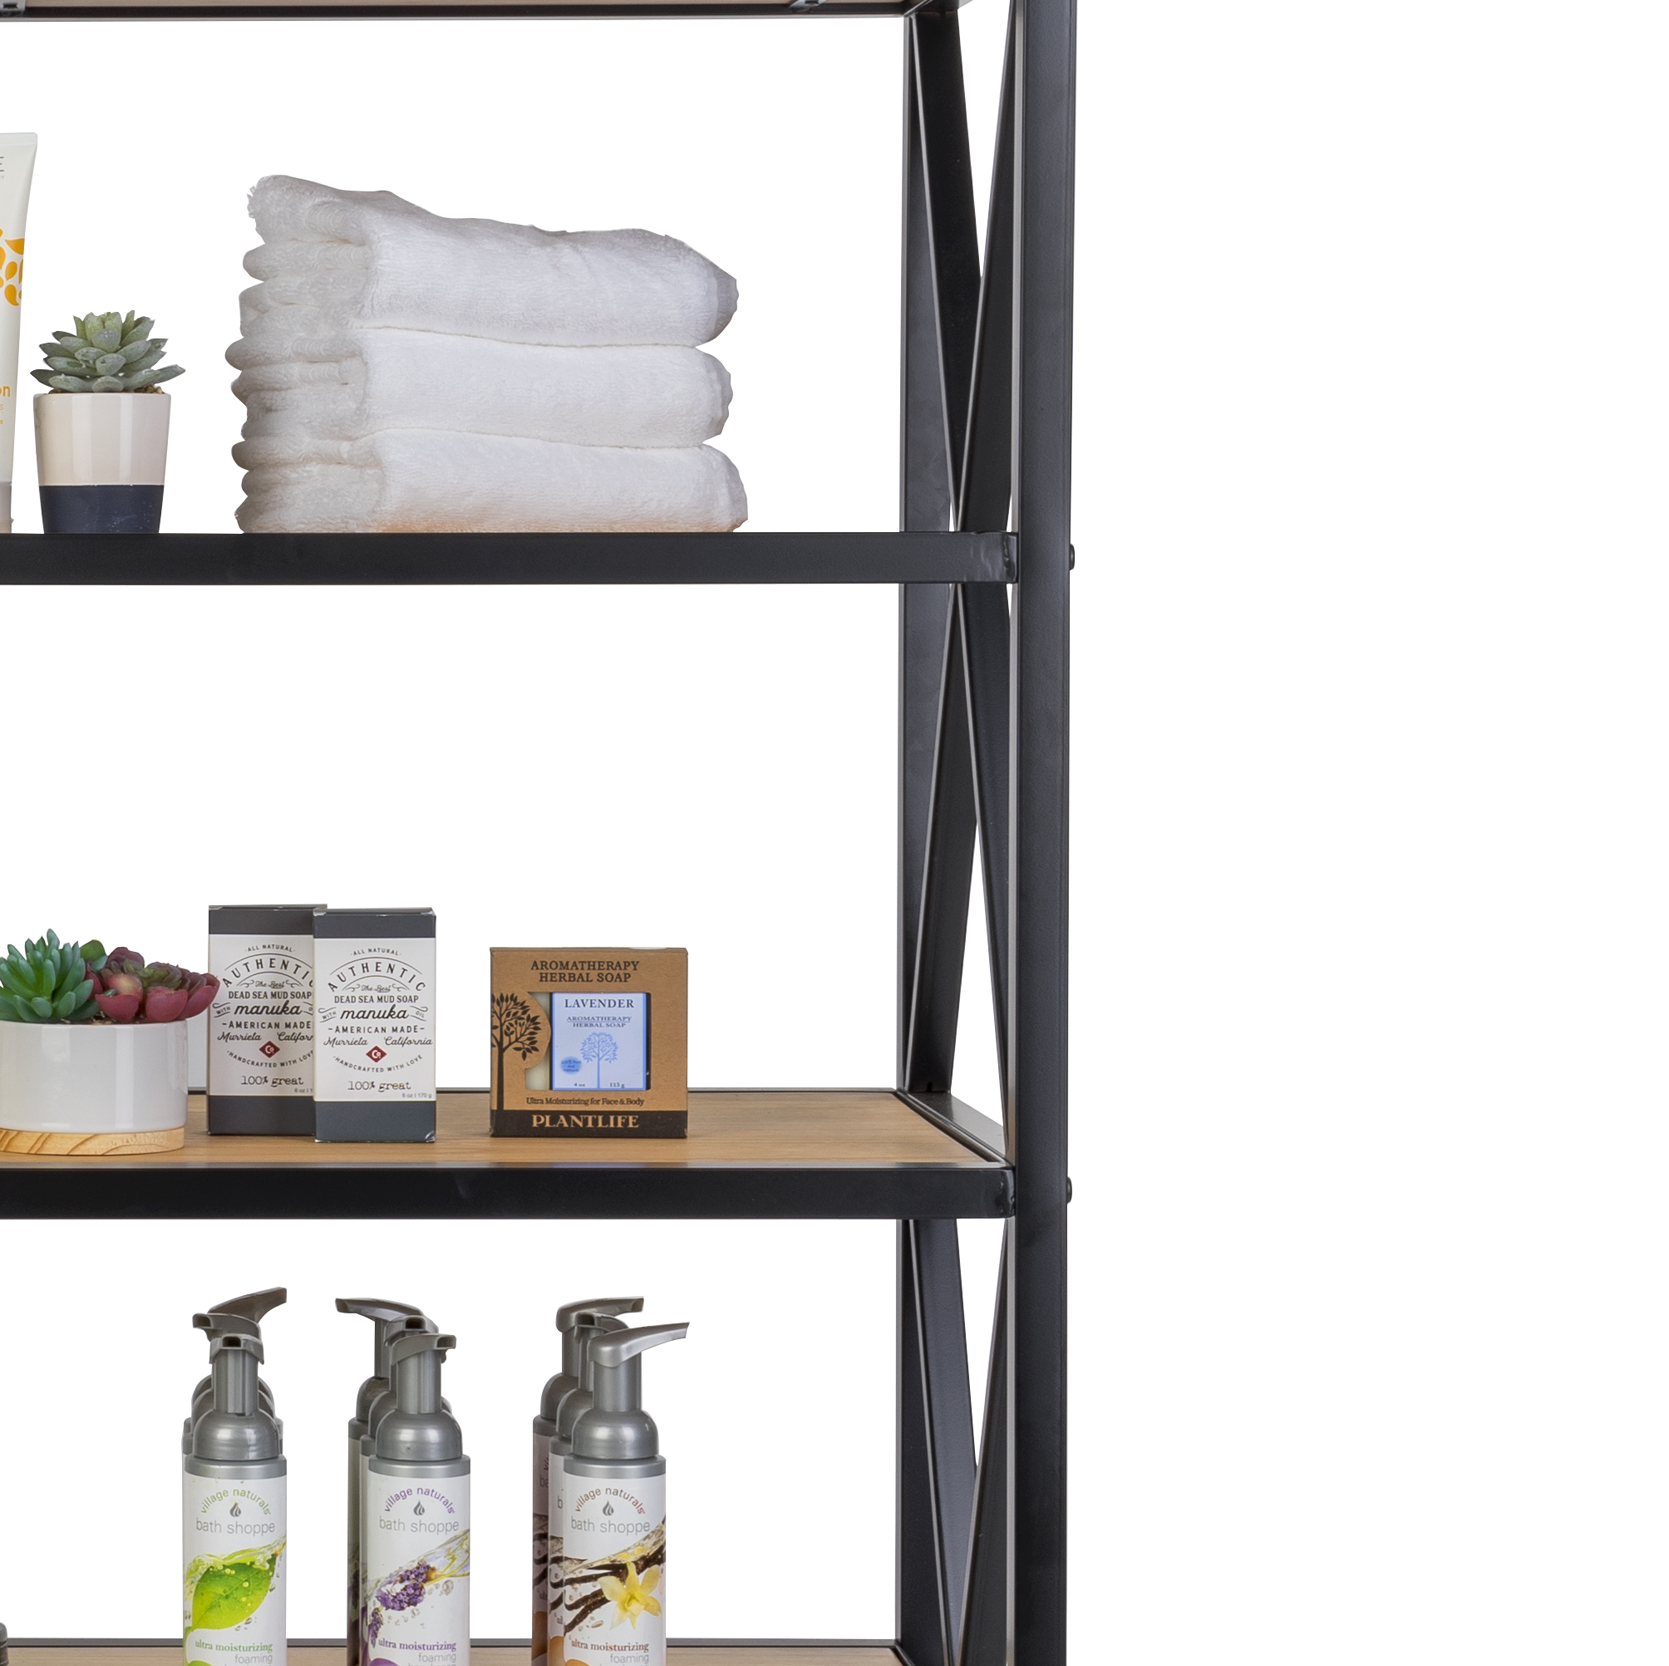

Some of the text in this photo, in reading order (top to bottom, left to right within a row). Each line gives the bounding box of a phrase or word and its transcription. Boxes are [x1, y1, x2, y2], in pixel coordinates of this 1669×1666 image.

[247, 944, 293, 953] ALL NATURAL
[353, 947, 399, 956] ALL NATURAL
[530, 960, 639, 971] AROMATHERAPY
[327, 961, 426, 992] AUTHENTIC
[539, 972, 631, 983] HERBAL SOAP
[228, 991, 312, 999] DEAD SEA MUD SOAP
[334, 995, 419, 1003] DEAD SEA MUD SOAP
[234, 1000, 303, 1015] manuka
[564, 998, 635, 1009] LAVENDER
[216, 1006, 231, 1015] WITH
[340, 1004, 410, 1020] manuka
[229, 1021, 312, 1030] AMERICAN MADE
[335, 1024, 418, 1034] AMERICAN MADE
[217, 1031, 313, 1043] Murrieta Califor
[323, 1035, 432, 1047] Murrieta California
[229, 1051, 278, 1068] HANDCRAFTED
[279, 1059, 297, 1067] WITH
[335, 1054, 423, 1072] HANDCRAFTED WITH LOVE
[241, 1075, 304, 1087] 100% great
[348, 1080, 412, 1093] 100% great
[545, 1097, 589, 1107] Moisturizing
[626, 1097, 645, 1107] Body
[532, 1114, 640, 1128] PLANTLIFE
[201, 1488, 271, 1515] village naturals
[384, 1487, 455, 1514] village naturals
[575, 1488, 602, 1513] village
[605, 1487, 645, 1515] naturals
[196, 1517, 275, 1537] bath shoppe
[379, 1515, 459, 1536] bath shoppe
[571, 1515, 650, 1536] bath shoppe
[195, 1639, 273, 1653] ultra moisturizing
[378, 1638, 457, 1653] ultra moisturizing
[571, 1639, 650, 1653] ultra moisturizing
[234, 1654, 273, 1664] foaming
[418, 1652, 457, 1664] foaming
[610, 1653, 650, 1664] foaming
